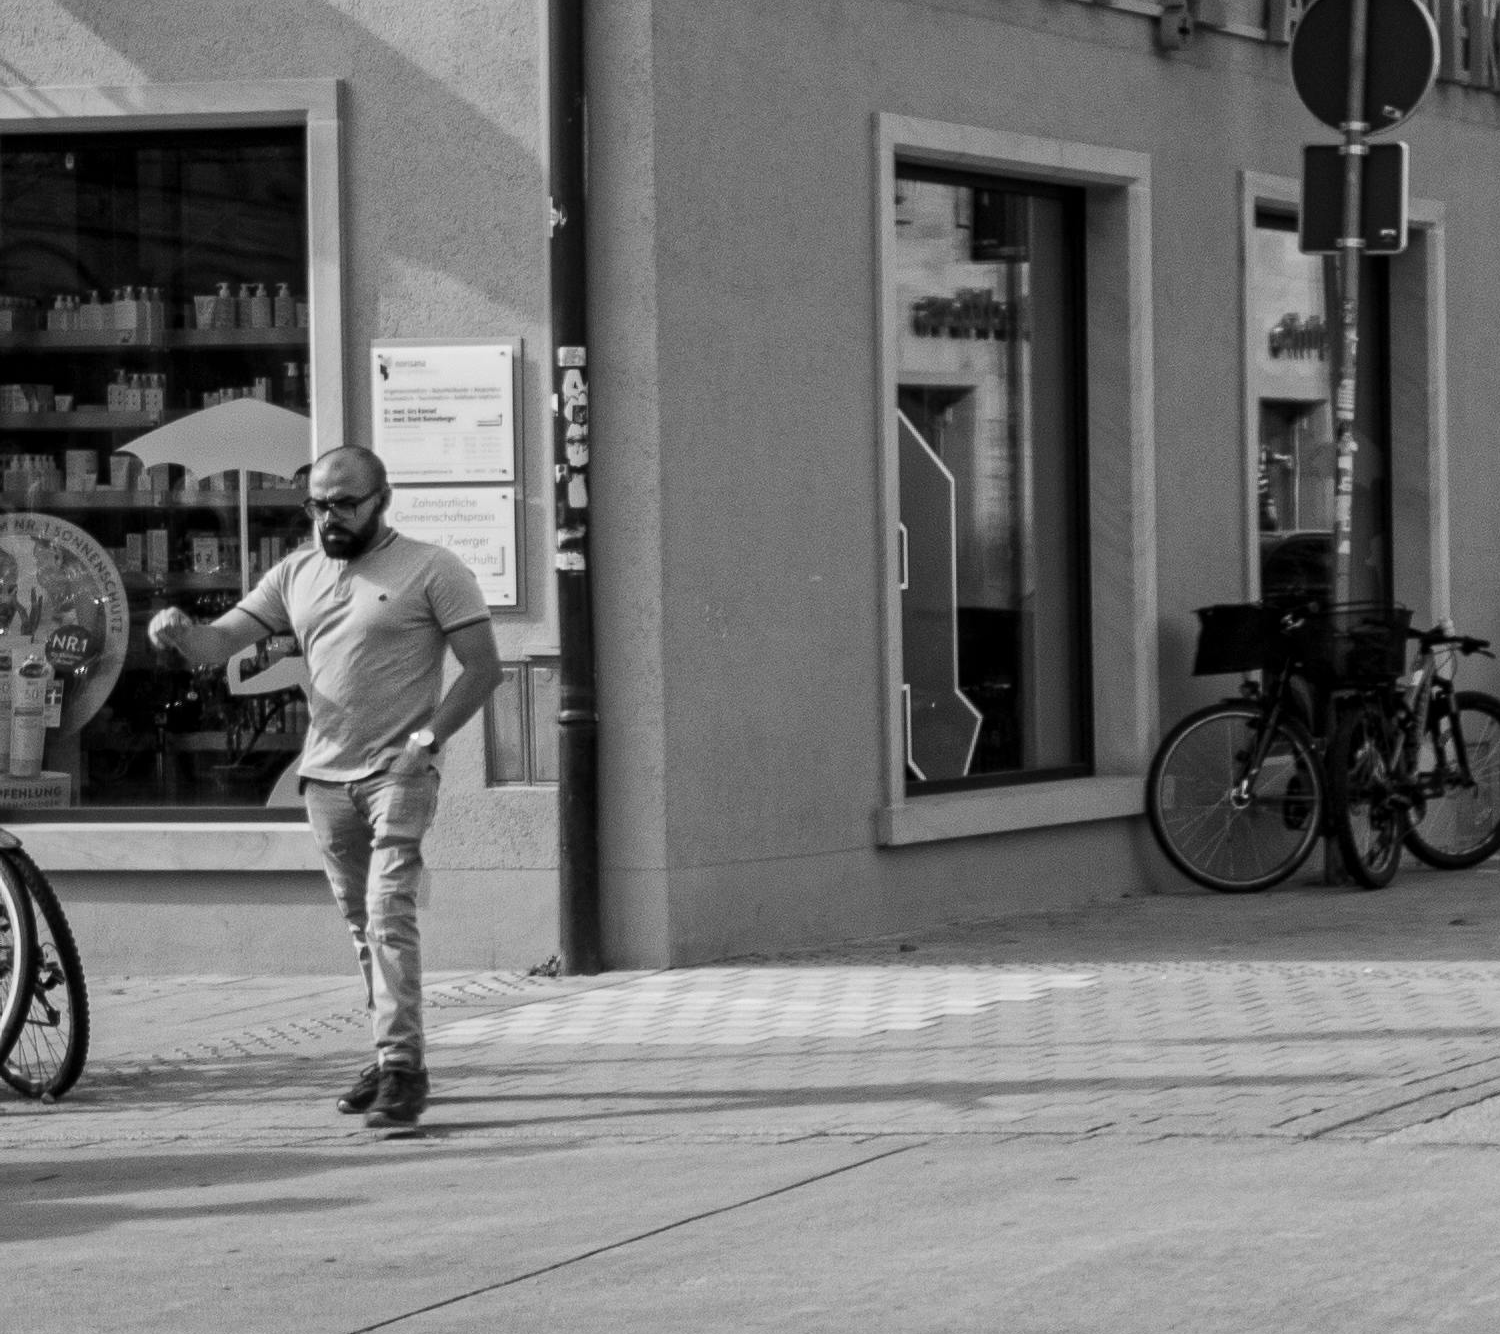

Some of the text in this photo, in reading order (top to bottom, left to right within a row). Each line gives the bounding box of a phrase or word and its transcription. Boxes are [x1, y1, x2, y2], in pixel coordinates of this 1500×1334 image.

[412, 497, 478, 508] Zahnärztliche
[394, 511, 496, 524] Gemeinschaftspraxis
[448, 534, 489, 548] Zwerger
[0, 786, 61, 799] FEHLUNG
